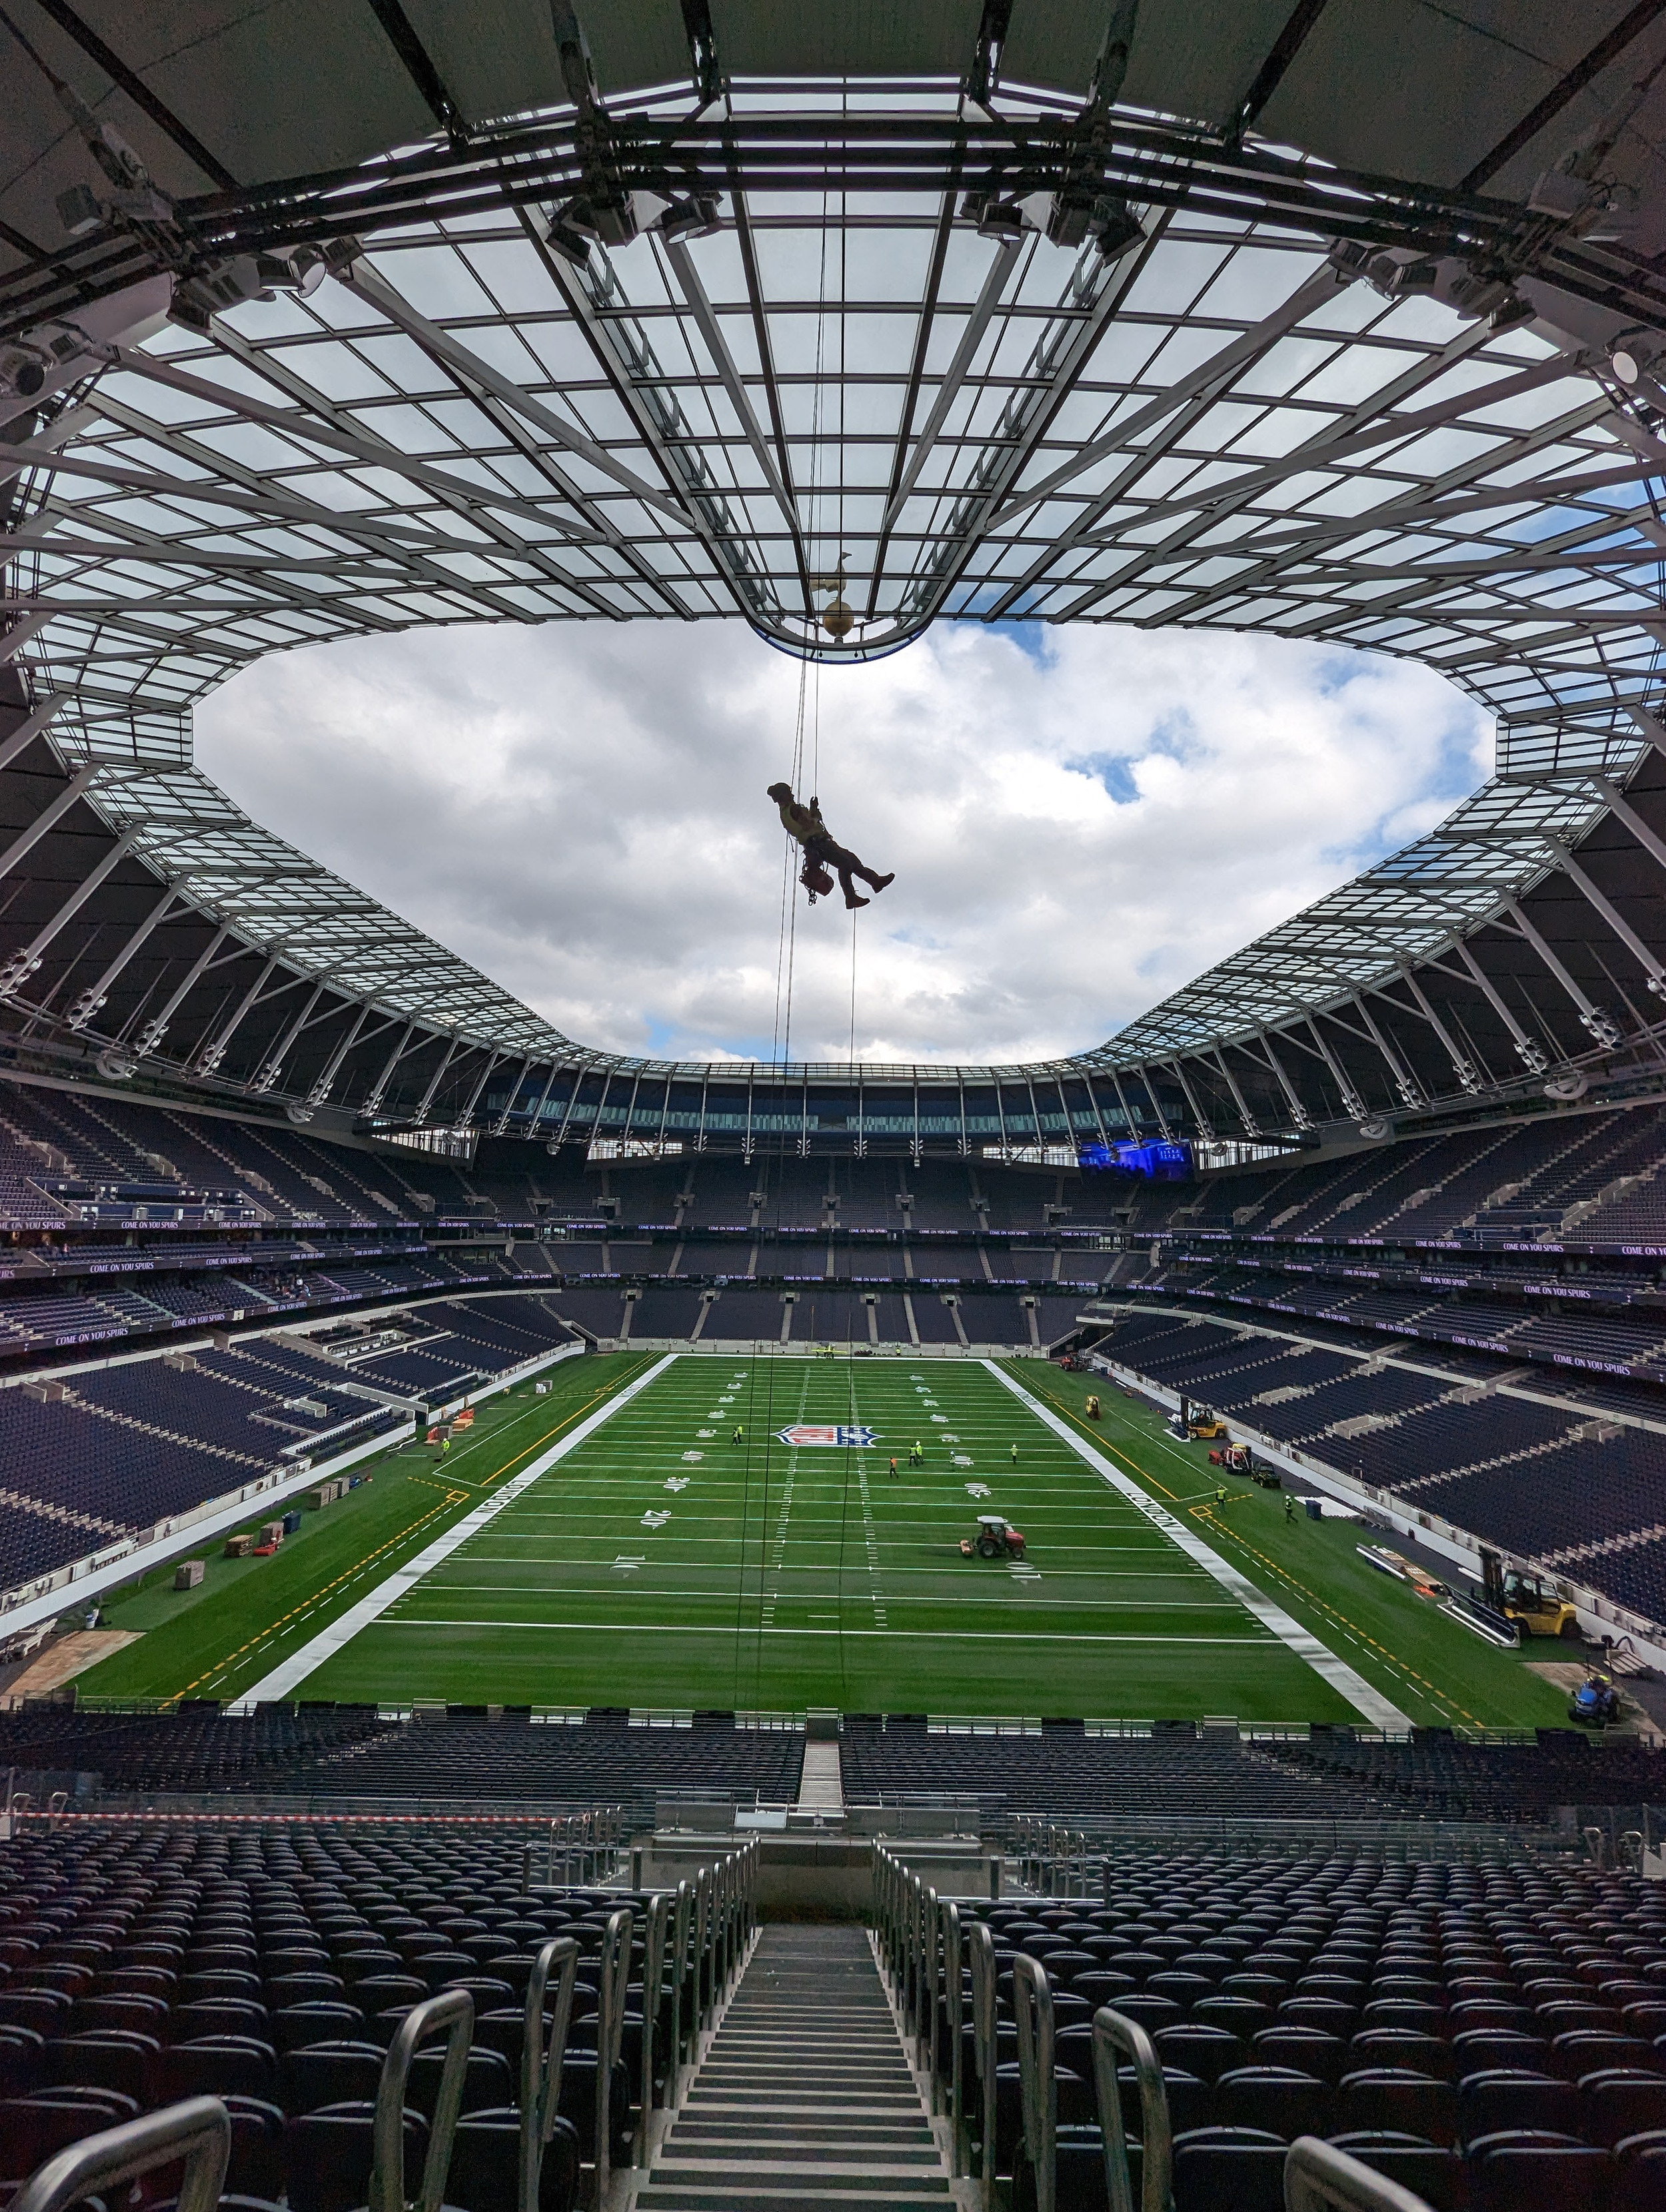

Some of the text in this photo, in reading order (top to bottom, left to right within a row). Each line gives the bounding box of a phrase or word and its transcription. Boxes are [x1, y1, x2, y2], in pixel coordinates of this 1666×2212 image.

[1622, 1246, 1644, 1255] COME
[1645, 1247, 1657, 1255] ON
[1452, 1279, 1468, 1287] SPURS
[1524, 1285, 1541, 1294] COME
[1553, 1288, 1567, 1297] YOU
[1568, 1289, 1591, 1299] SPURS
[172, 1319, 187, 1328] COME
[198, 1315, 209, 1324] YOU
[209, 1313, 225, 1322] SPURS
[56, 1327, 128, 1346] COME ON YOU SPURS
[1404, 1327, 1419, 1336] SPURS
[1452, 1335, 1509, 1353] COME ON YOU SPURS
[1553, 1353, 1630, 1376] COME ON YOU SPURS
[788, 1427, 834, 1444] NFL
[663, 1476, 690, 1488] 30
[474, 1480, 531, 1514] LONDON
[640, 1510, 672, 1525] 20
[1126, 1492, 1183, 1528] LONDON
